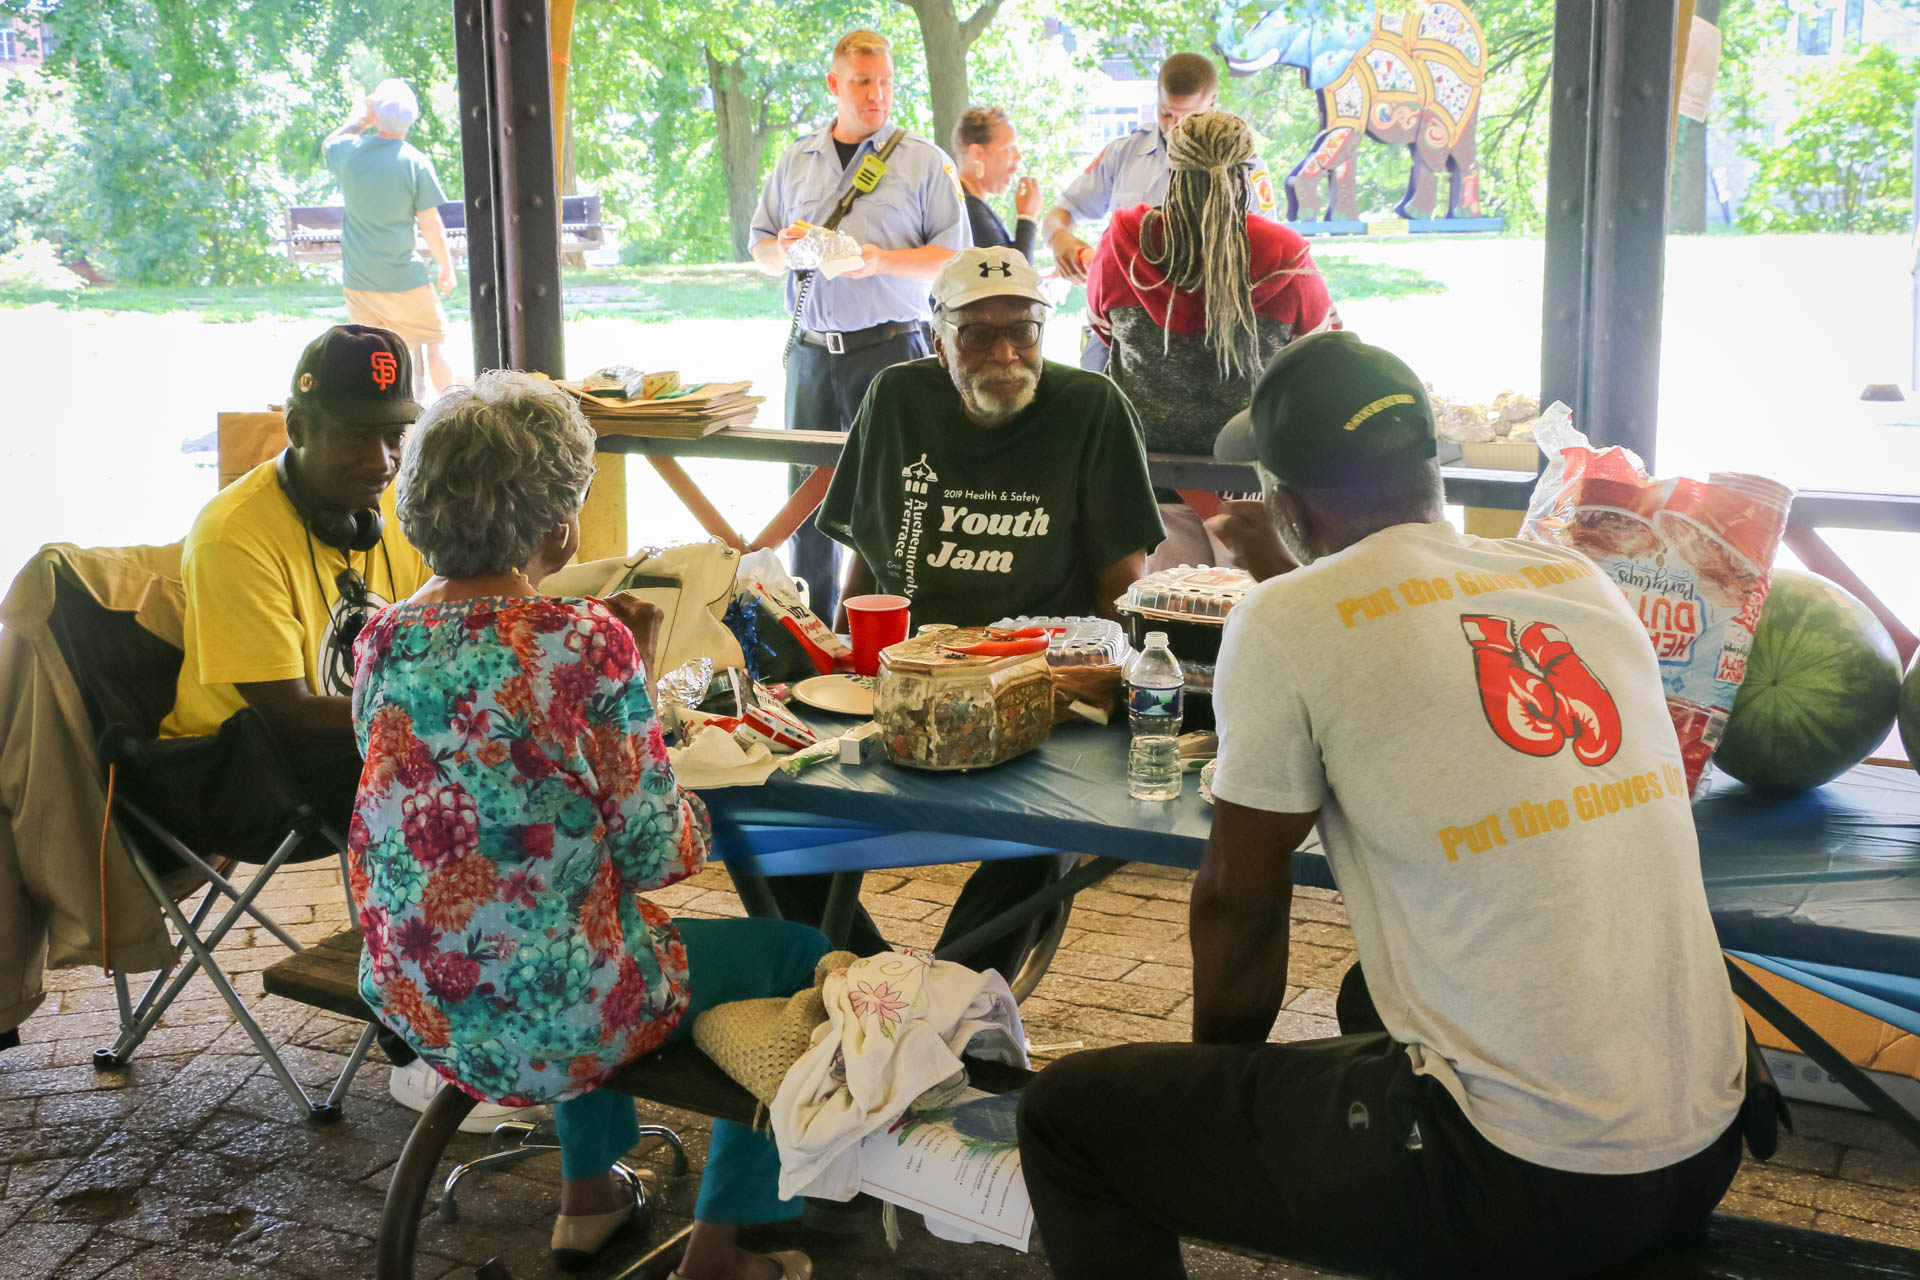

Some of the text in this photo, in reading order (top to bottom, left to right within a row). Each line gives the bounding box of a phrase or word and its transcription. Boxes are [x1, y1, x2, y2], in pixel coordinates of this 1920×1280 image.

[370, 351, 398, 391] SF
[943, 489, 1041, 504] 2019 Health & Safety
[894, 497, 914, 558] Terrace
[938, 505, 1050, 538] Youth
[903, 498, 928, 598] Auchentoroly
[926, 541, 1014, 574] Jam
[1335, 559, 1596, 629] Put the Guns Down
[1618, 567, 1695, 601] Party Cups
[1630, 593, 1696, 634] DUT
[1437, 813, 1508, 862] Put
[1508, 797, 1570, 839] the
[1572, 770, 1664, 822] Gloves
